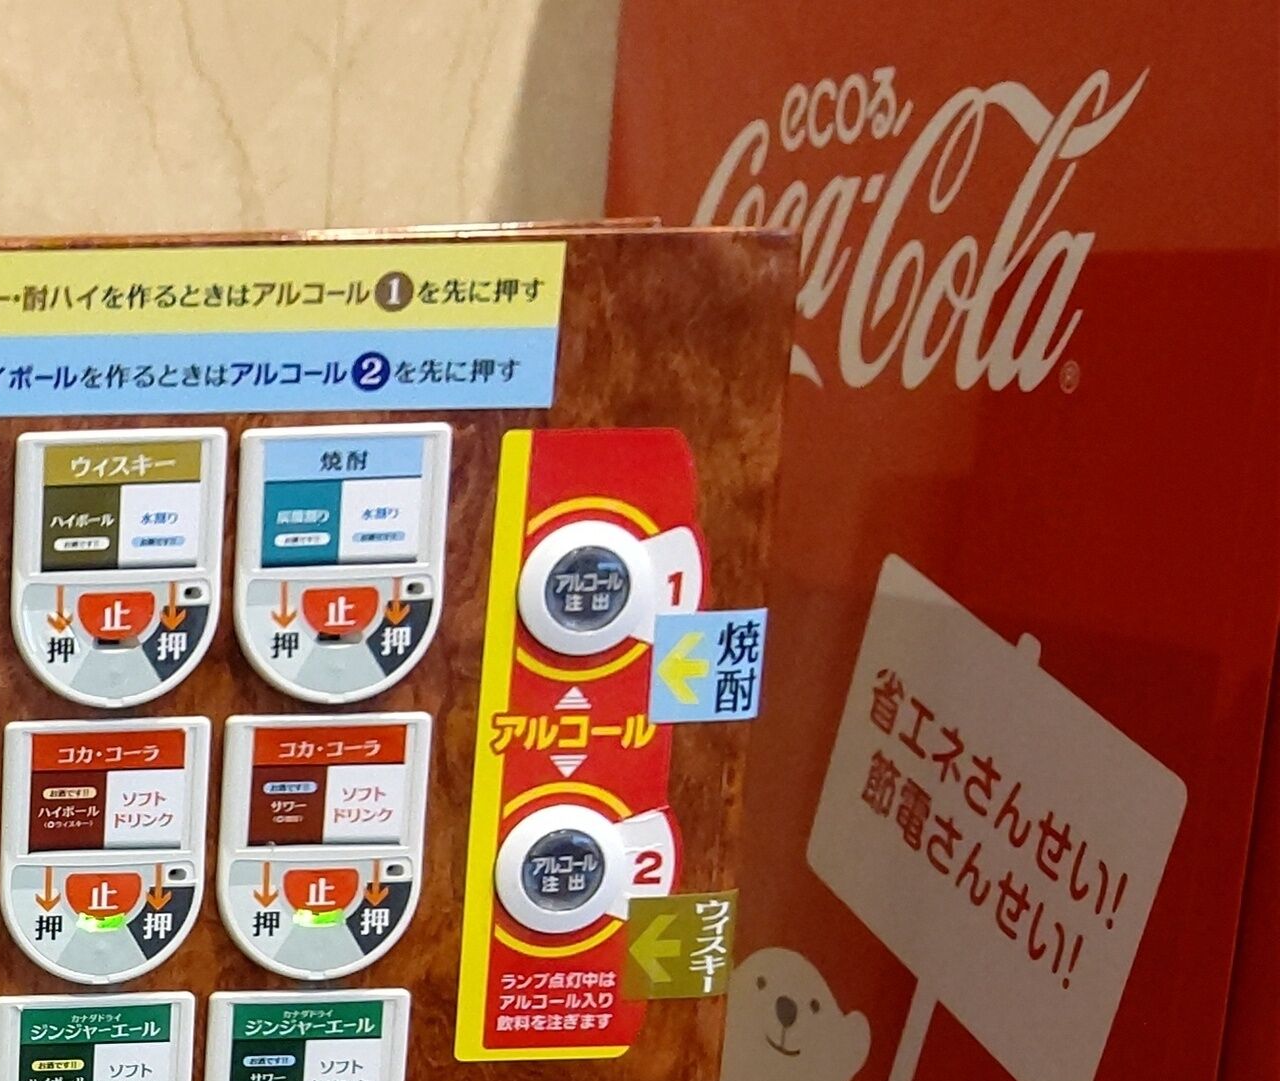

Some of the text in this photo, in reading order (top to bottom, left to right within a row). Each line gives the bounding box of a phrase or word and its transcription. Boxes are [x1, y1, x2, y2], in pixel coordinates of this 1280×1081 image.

[71, 453, 177, 478] ウィスキー
[319, 450, 368, 472] 焼酎
[49, 512, 115, 528] ハイボール
[554, 573, 625, 593] アルコール
[667, 570, 684, 607] 1
[100, 600, 132, 631] 止
[324, 596, 357, 627] 止
[47, 637, 75, 663] 押
[157, 632, 188, 661] 押
[271, 632, 299, 659] 押
[381, 626, 411, 656] 押
[715, 620, 761, 714] 焼酎
[490, 712, 657, 750] アルコール
[57, 745, 160, 764] コカ・コーラ
[278, 740, 382, 759] コカ・コーラ
[122, 791, 167, 807] ソフト
[342, 786, 386, 802] ソフト
[38, 805, 101, 818] ハイボール
[271, 800, 307, 813] サワー
[333, 807, 394, 824] ドリンク
[113, 812, 174, 829] ドリンク
[531, 853, 598, 876] アルコール
[632, 850, 663, 885] 2
[305, 878, 337, 907] 止
[541, 875, 586, 893] 注出
[88, 882, 118, 910] 止
[35, 915, 62, 940] 押
[143, 913, 172, 940] 押
[252, 911, 280, 937] 押
[360, 908, 390, 935] 押
[500, 971, 616, 990] ランプ点灯中は
[498, 992, 614, 1011] アルコール入り
[70, 1013, 122, 1023] カナダドライ
[244, 1017, 376, 1037] ジンジャーエール
[496, 1013, 613, 1033] 飲料を注ぎます
[30, 1021, 161, 1041] ジンジャーエール
[109, 1063, 153, 1079] ソフト
[320, 1059, 364, 1075] ソフト
